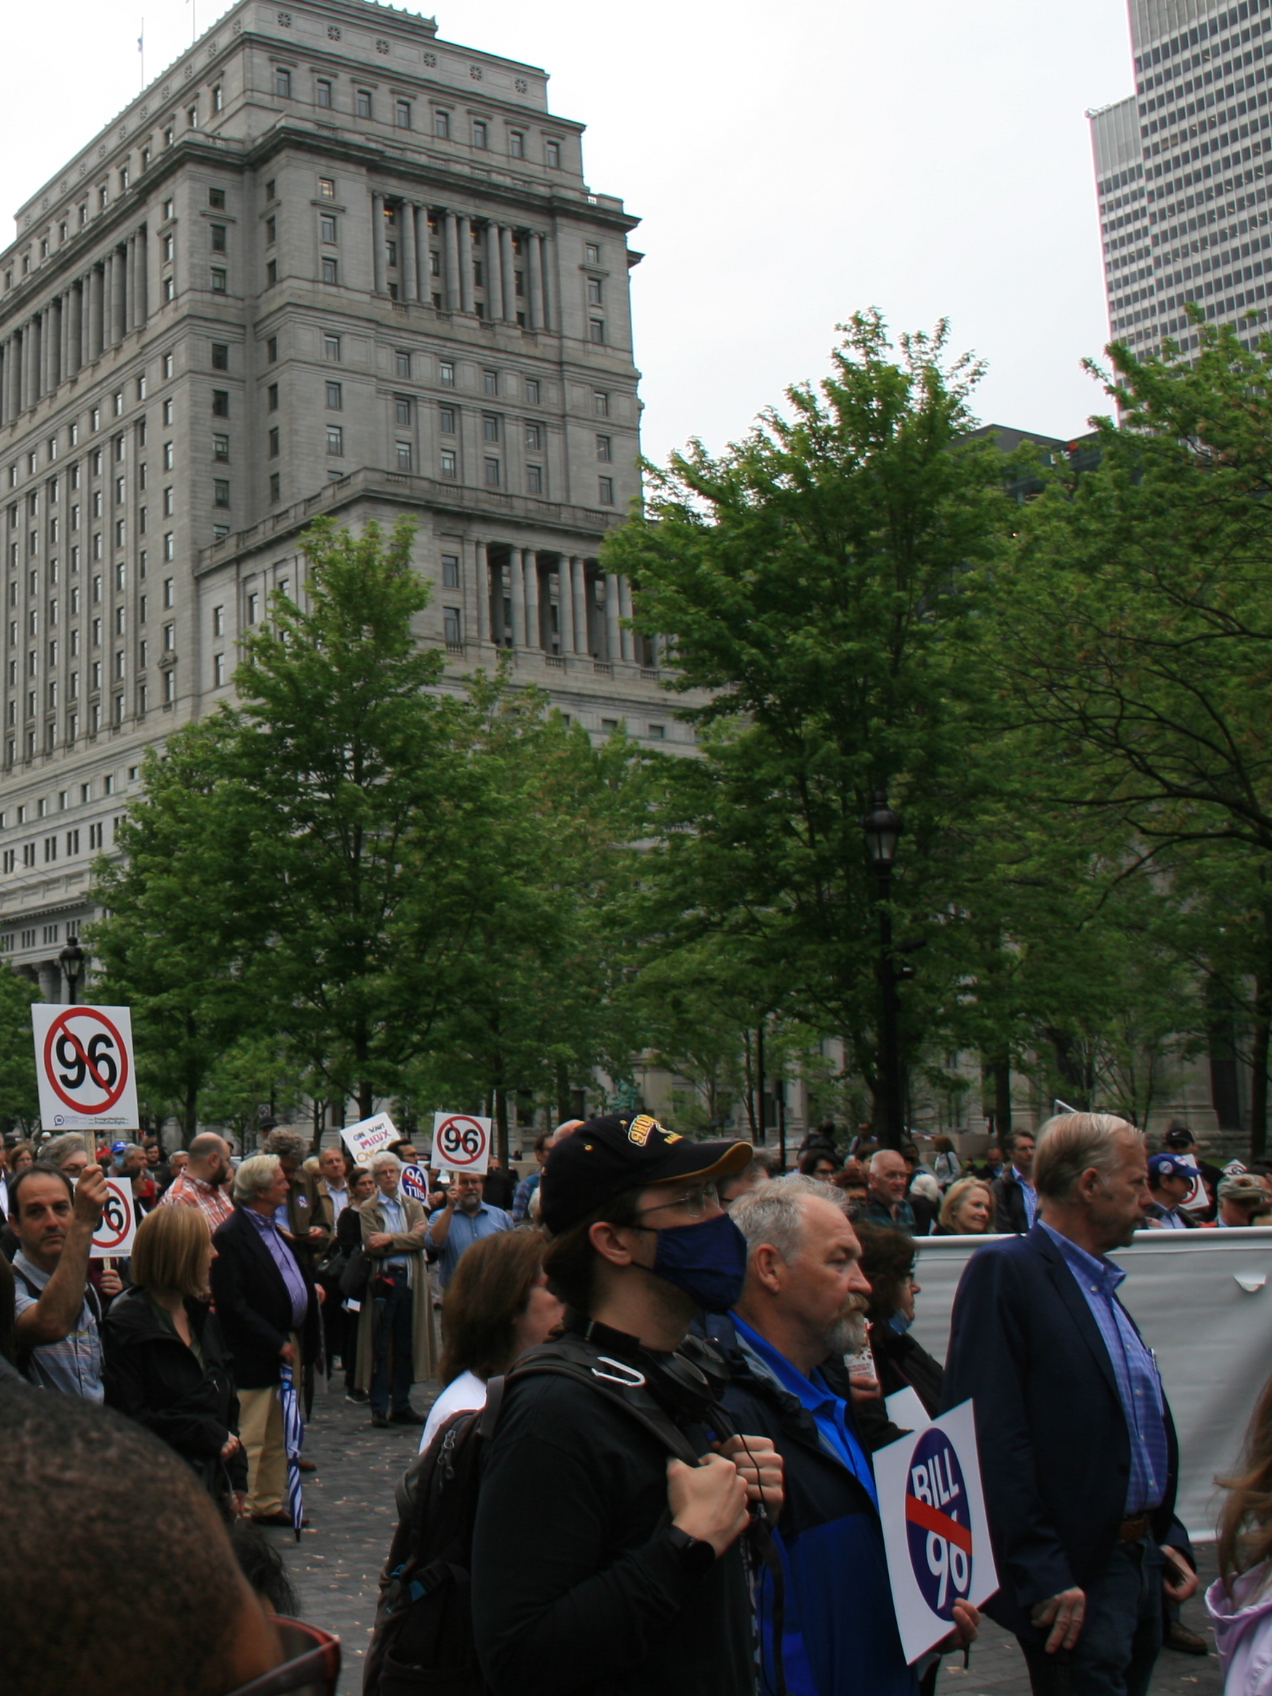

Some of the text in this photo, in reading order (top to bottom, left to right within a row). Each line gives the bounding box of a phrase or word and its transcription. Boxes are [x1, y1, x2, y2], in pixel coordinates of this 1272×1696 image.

[55, 1033, 117, 1090] 96
[359, 1129, 391, 1150] MIEUX
[443, 1127, 479, 1154] 96
[405, 1168, 423, 1186] 96
[911, 1448, 959, 1509] BILL
[926, 1510, 968, 1610] 96
